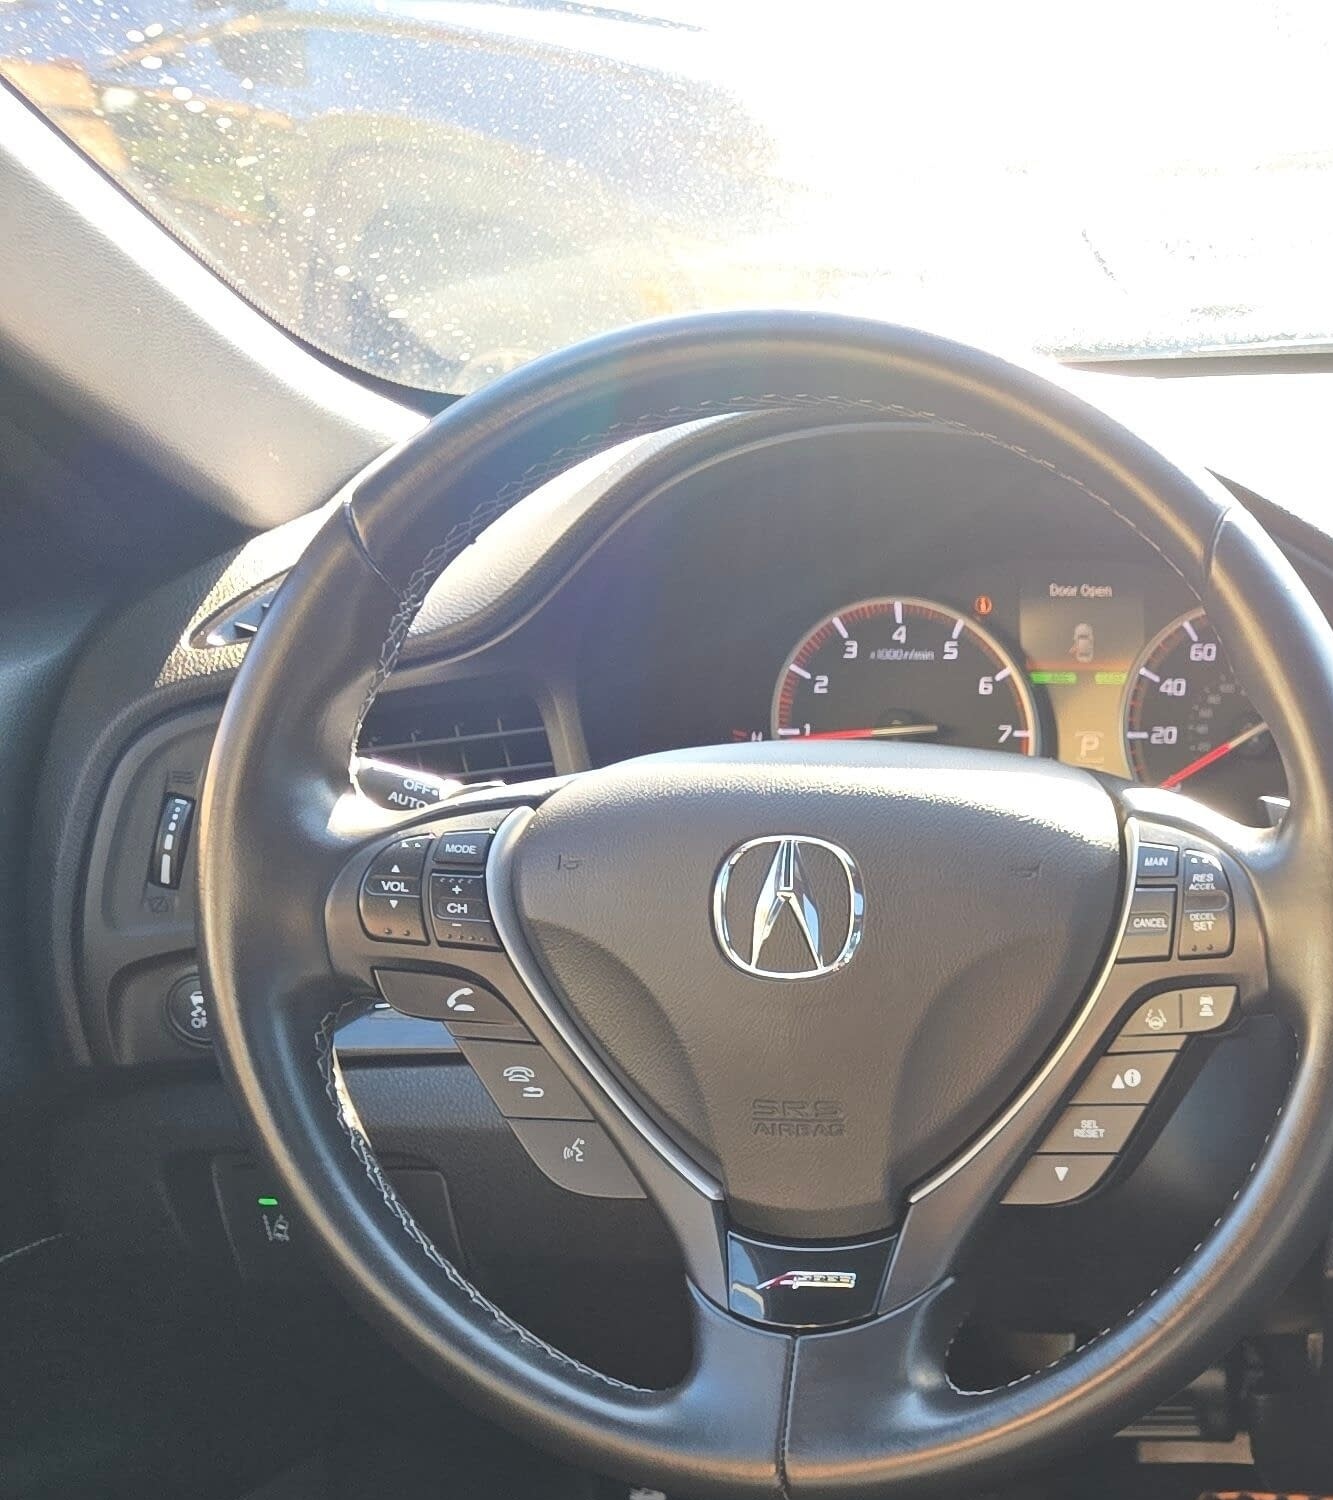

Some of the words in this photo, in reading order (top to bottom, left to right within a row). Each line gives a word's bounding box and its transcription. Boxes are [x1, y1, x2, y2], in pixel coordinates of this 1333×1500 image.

[1049, 583, 1077, 598] Door
[1080, 583, 1112, 599] Open
[892, 625, 907, 644] 4
[843, 640, 858, 659] 3
[943, 641, 959, 660] 5
[1189, 643, 1217, 662] 60
[813, 675, 829, 694] 2
[978, 676, 993, 695] 6
[1159, 678, 1186, 697] 40
[803, 723, 811, 737] 1
[997, 724, 1012, 743] 7
[1150, 726, 1178, 745] 20
[1080, 735, 1099, 759] P
[403, 778, 431, 796] OFF
[388, 791, 428, 810] AUTO
[445, 843, 477, 854] MODE
[1144, 857, 1168, 867] MAIN
[381, 880, 409, 893] VOL
[1192, 873, 1214, 883] RES
[446, 902, 468, 914] CH
[1133, 918, 1168, 928] CANCEL
[1193, 921, 1214, 931] SET
[752, 1099, 844, 1119] SRS
[753, 1123, 845, 1137] AIRBAG
[1081, 1119, 1099, 1129] SEL
[1073, 1129, 1105, 1138] RESET
